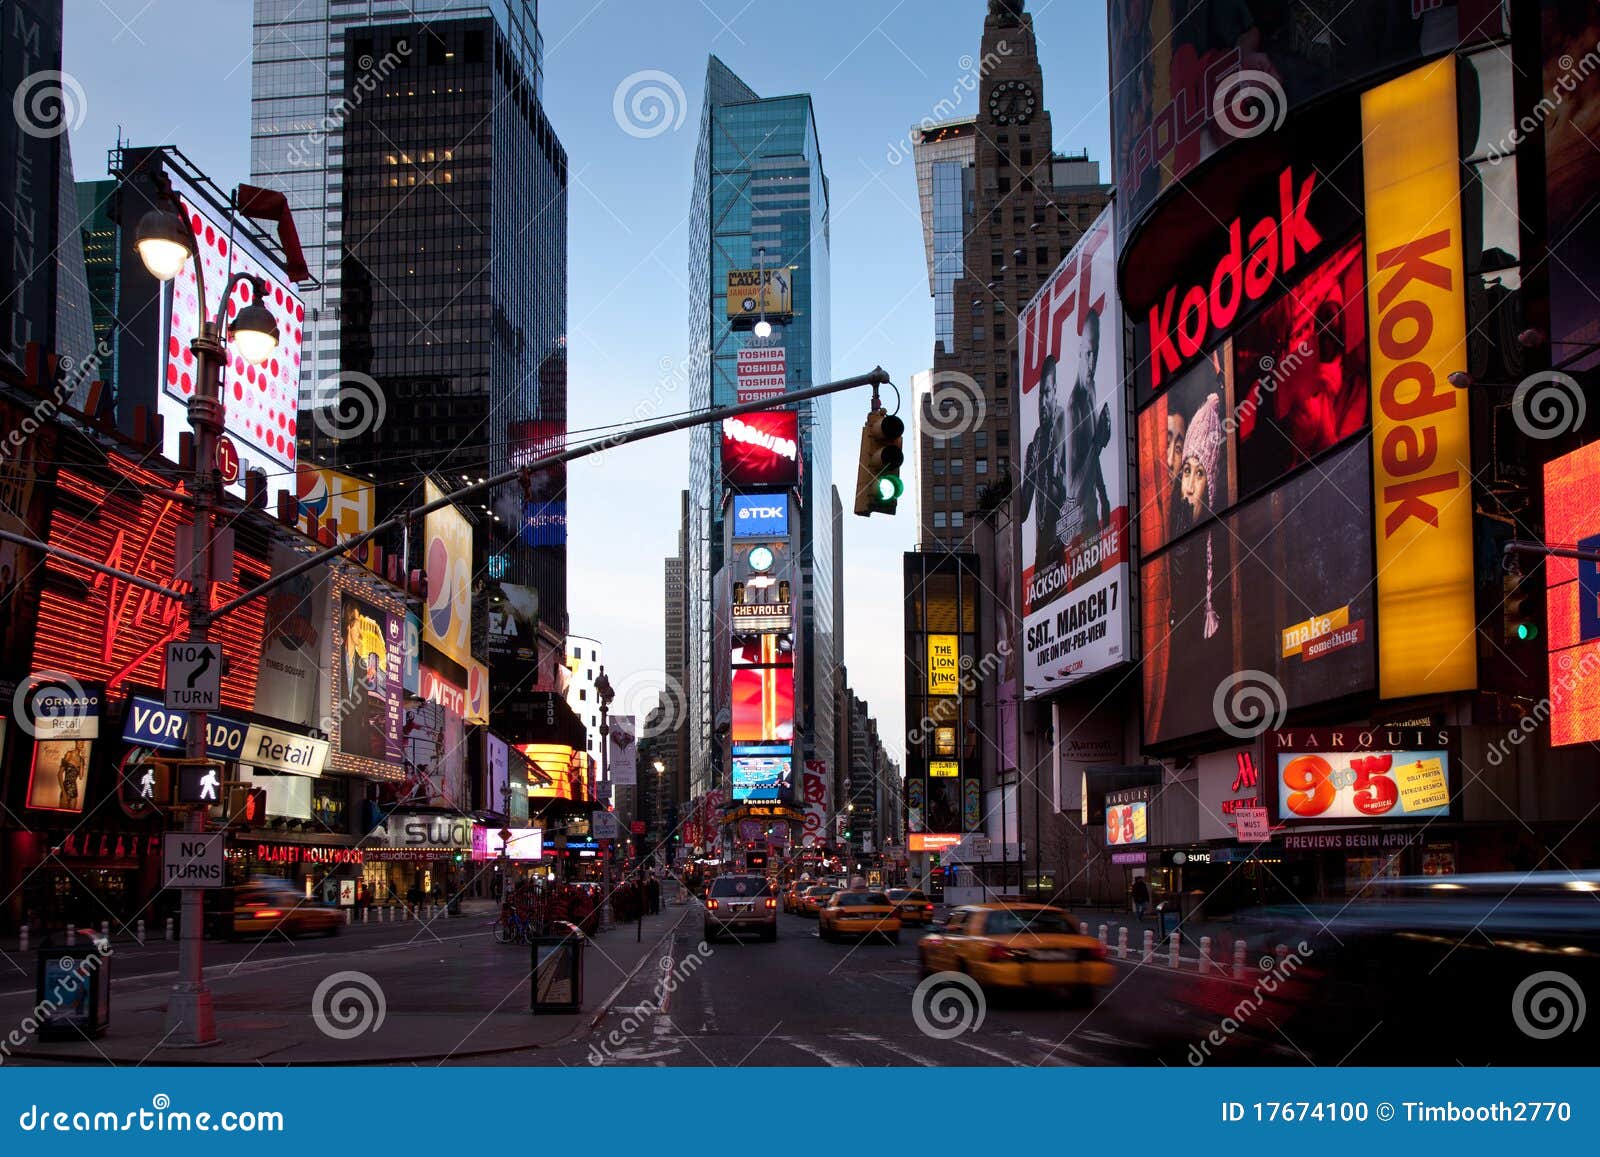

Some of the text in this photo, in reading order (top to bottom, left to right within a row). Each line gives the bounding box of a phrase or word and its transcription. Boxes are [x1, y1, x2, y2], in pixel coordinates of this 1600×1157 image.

[1149, 164, 1323, 389] Kodak
[1022, 222, 1109, 395] UFC
[739, 350, 784, 360] TOSHIBA
[738, 363, 785, 373] TOSHIBA
[738, 377, 785, 387] TOSHIBA
[1376, 228, 1459, 540] Kodak
[749, 506, 784, 519] TDK
[1071, 530, 1119, 580] JARDINE
[1025, 562, 1068, 606] JACKSON
[733, 604, 790, 617] CHEVROLET
[1057, 587, 1108, 639] MARCH
[1110, 581, 1118, 611] 7
[1285, 616, 1331, 650] make
[935, 645, 952, 655] THE
[1037, 645, 1050, 667] LIVE
[1050, 641, 1060, 661] ON
[1060, 619, 1107, 657] PAY-PER-VIEW
[1308, 628, 1358, 656] something
[172, 648, 196, 662] NO
[931, 657, 955, 671] LION
[931, 672, 956, 688] KING
[37, 697, 98, 706] VORNADO
[173, 689, 213, 705] TURN
[53, 718, 81, 730] Retail
[1277, 731, 1450, 750] MARQUIS
[256, 735, 313, 770] Retail
[1283, 754, 1336, 816] 9
[1350, 753, 1399, 815] 5
[742, 798, 782, 806] Panasonic
[1107, 791, 1148, 804] MARQUIS
[1243, 820, 1260, 829] MUST
[1285, 835, 1342, 850] PREVIEWS
[1345, 834, 1379, 847] BEGIN
[1381, 833, 1412, 847] APRIL
[180, 843, 206, 858] NO
[257, 844, 363, 864] PLANET HOLLYWOOD
[379, 851, 418, 860] swatch
[167, 864, 220, 881] TURNS
